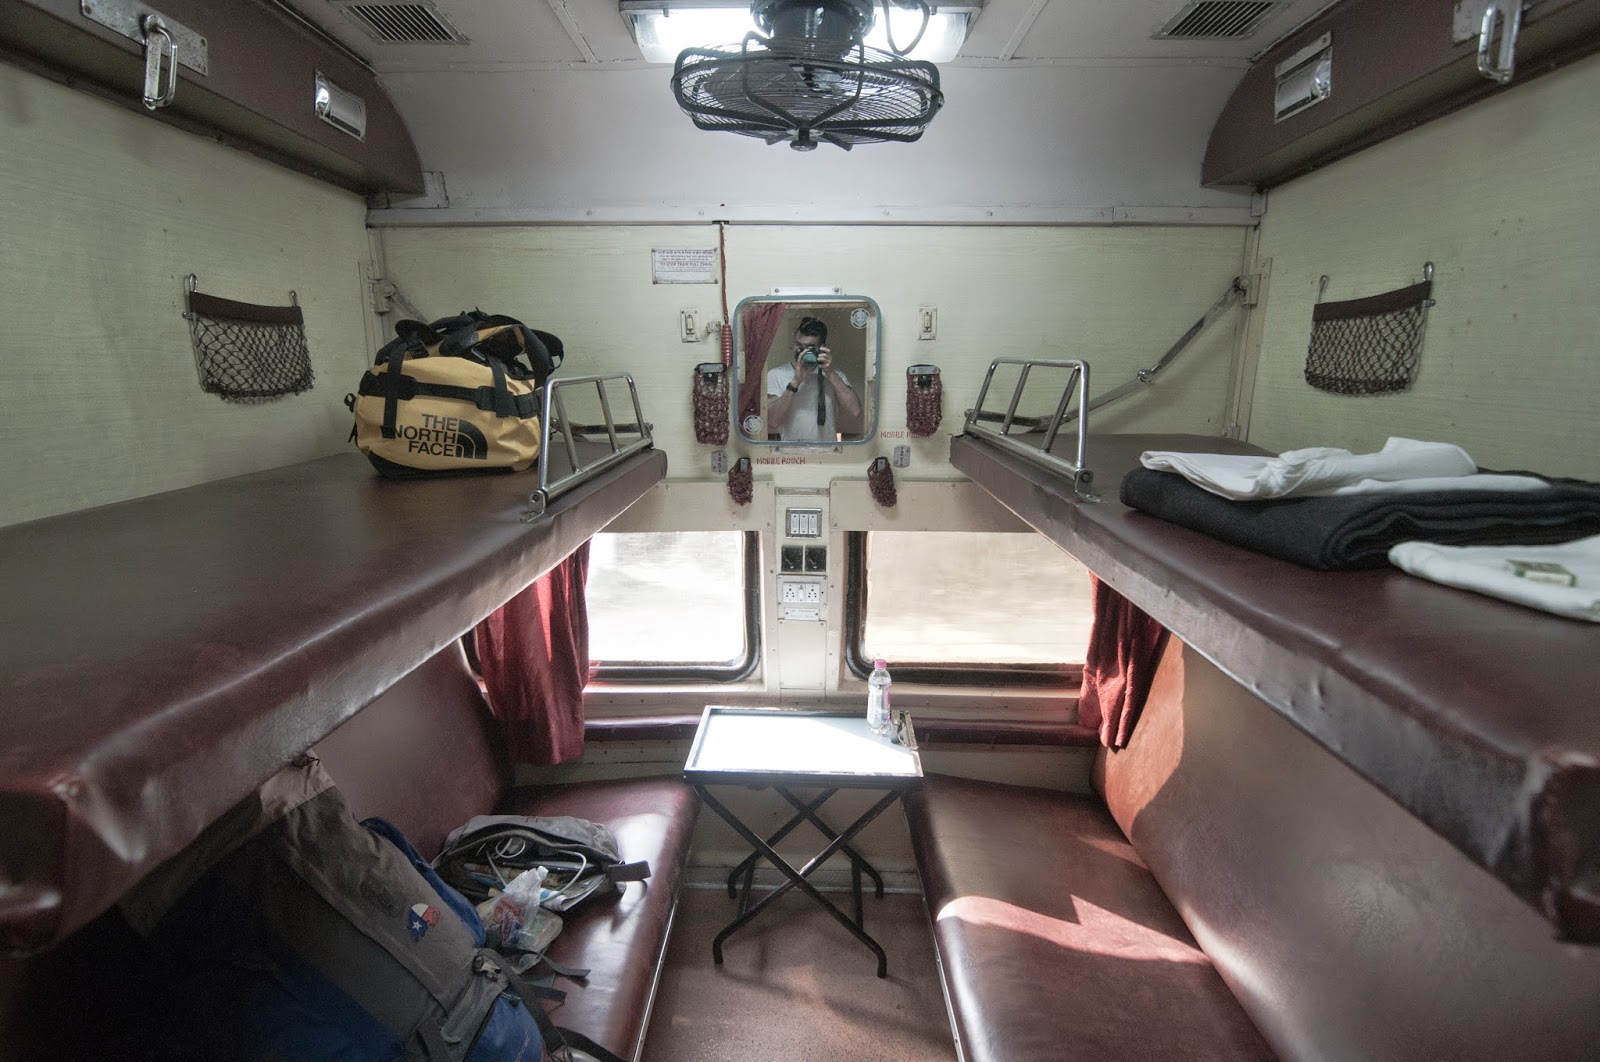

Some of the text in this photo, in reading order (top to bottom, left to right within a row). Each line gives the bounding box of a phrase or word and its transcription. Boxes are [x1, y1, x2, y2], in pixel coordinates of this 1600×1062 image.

[422, 413, 458, 432] THE
[395, 424, 456, 444] NORTH
[880, 431, 905, 439] MOBILE
[408, 440, 454, 457] FACE
[756, 457, 806, 465] MOBILE POUCH
